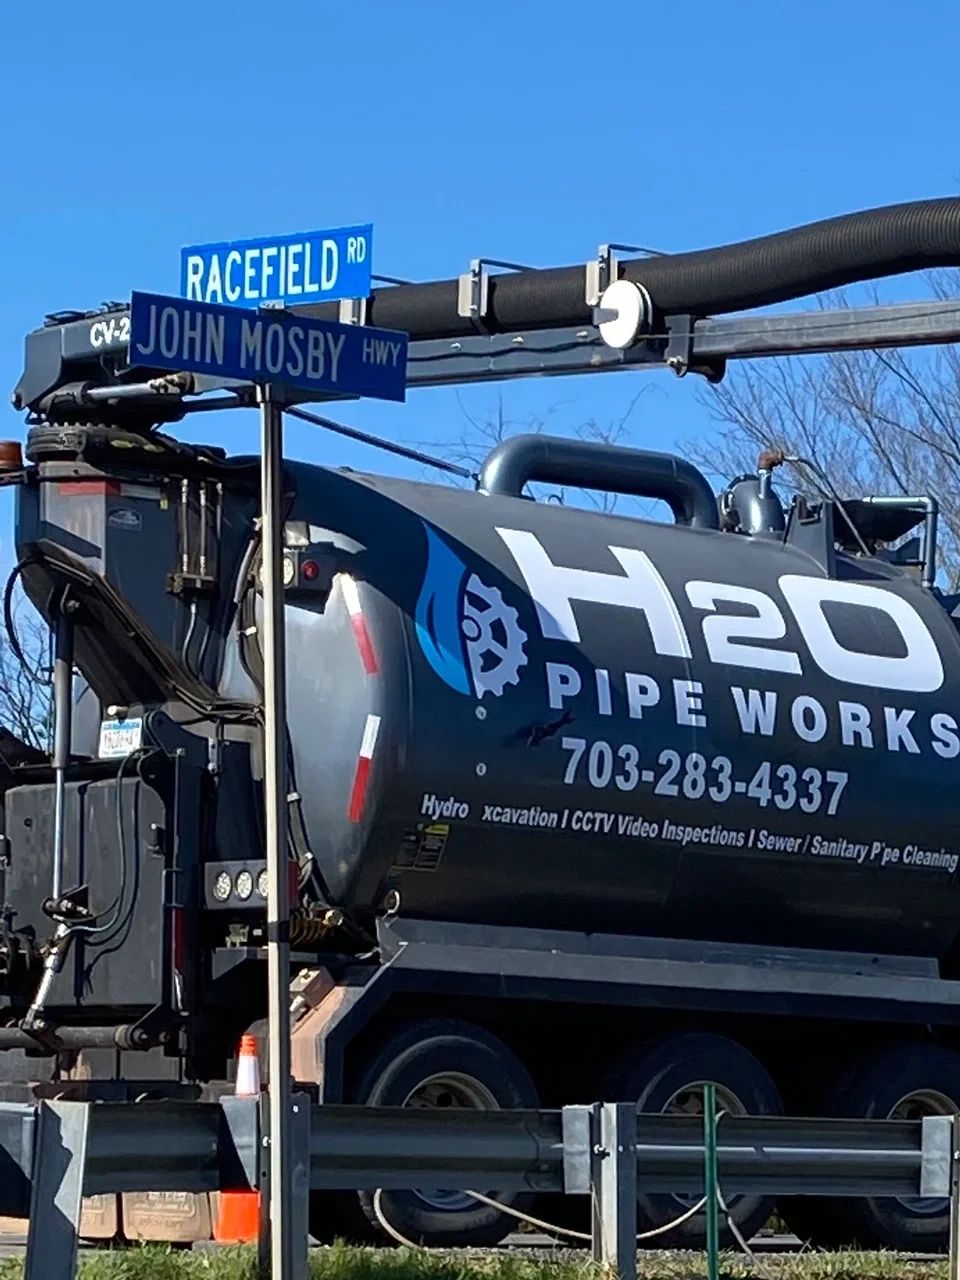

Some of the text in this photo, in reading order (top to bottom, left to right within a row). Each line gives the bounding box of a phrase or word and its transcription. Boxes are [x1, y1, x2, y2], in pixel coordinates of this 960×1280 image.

[186, 236, 366, 303] RACEFIELD RD
[136, 305, 401, 382] JOHN MOSBY HWY
[495, 527, 944, 692] H2O
[546, 662, 707, 728] PIPE
[561, 737, 848, 815] 703-283-4337
[421, 794, 469, 820] Hydro
[481, 804, 558, 829] xcavation
[571, 810, 615, 833] CCTV
[617, 815, 659, 839] Video
[661, 819, 745, 847] Inspections
[757, 829, 802, 853] Sewer
[811, 836, 869, 864] Sanitary
[869, 840, 901, 866] Ppe
[902, 844, 959, 872] Cleaning
